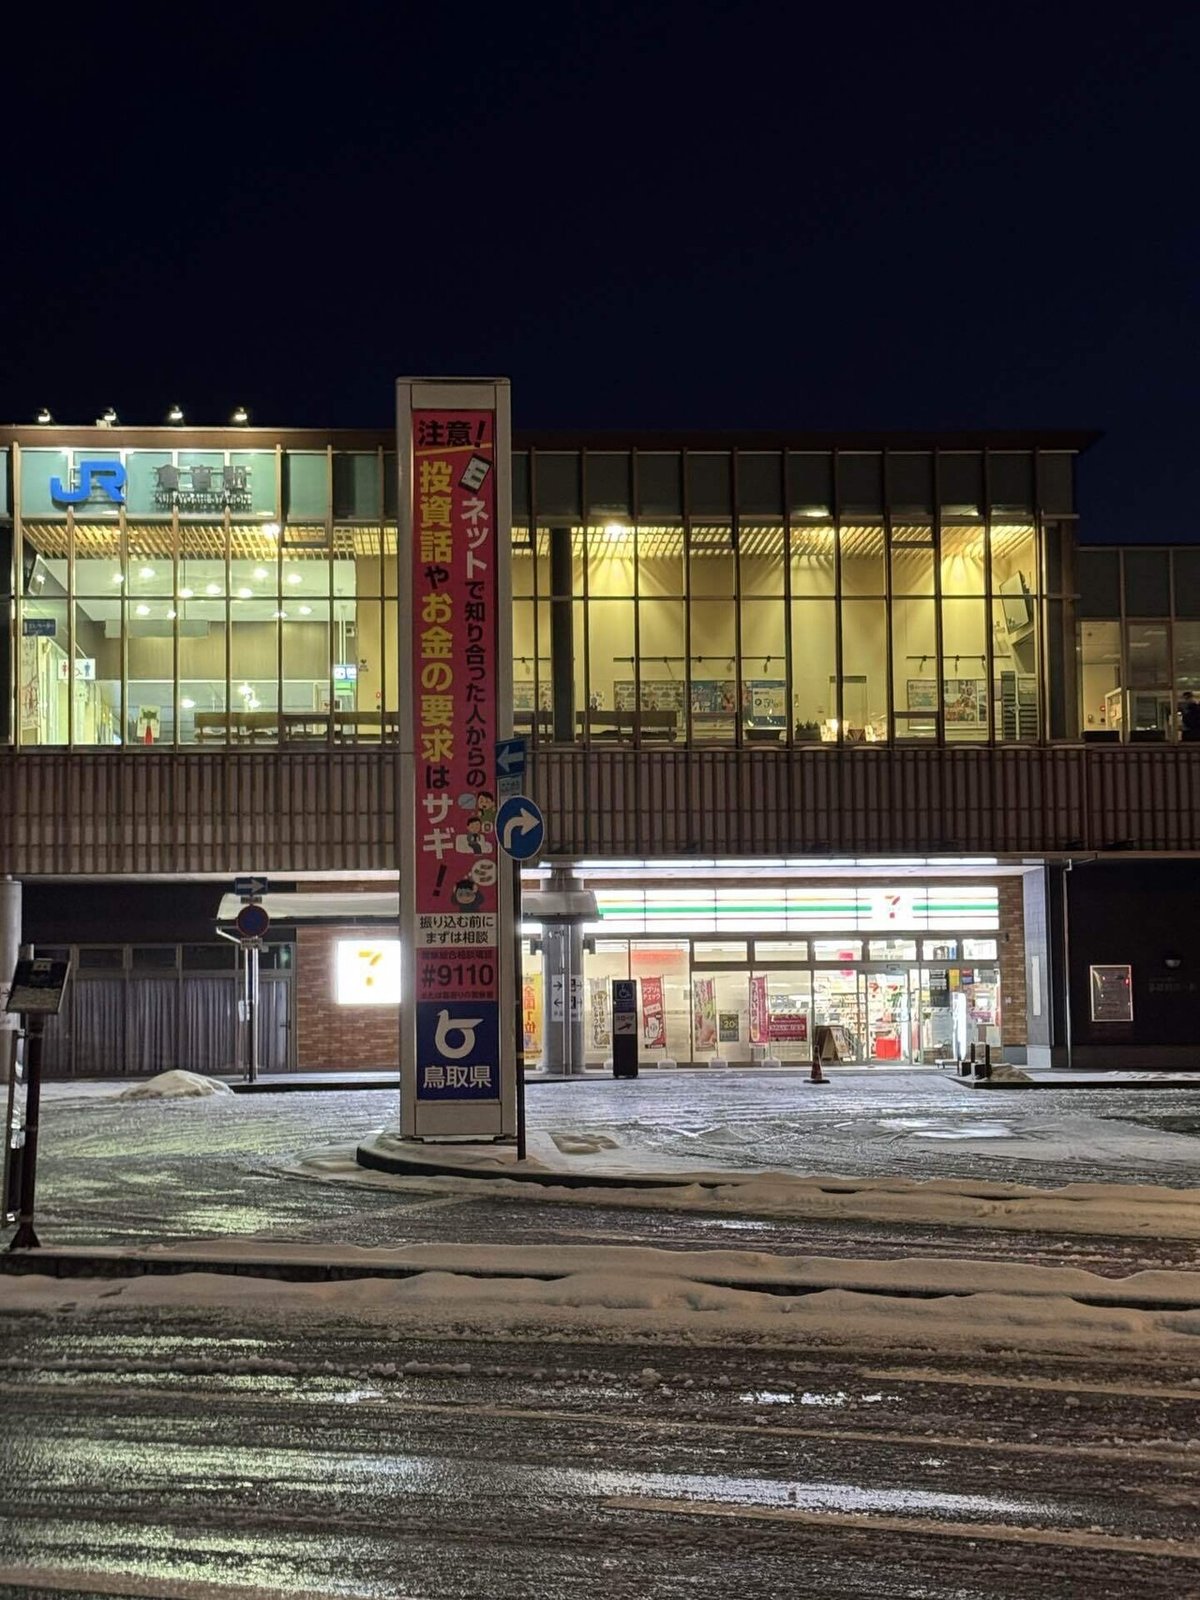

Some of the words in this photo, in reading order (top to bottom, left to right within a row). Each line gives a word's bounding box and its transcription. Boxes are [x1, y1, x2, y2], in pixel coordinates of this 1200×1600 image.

[418, 420, 486, 448] 注意!
[50, 461, 126, 502] JR
[460, 497, 488, 788] ネットで知り合った人からの
[420, 915, 494, 929] 振り込む前に
[426, 931, 489, 944] まずは相談
[422, 963, 494, 988] #9110
[423, 1066, 492, 1089] 鳥取県
